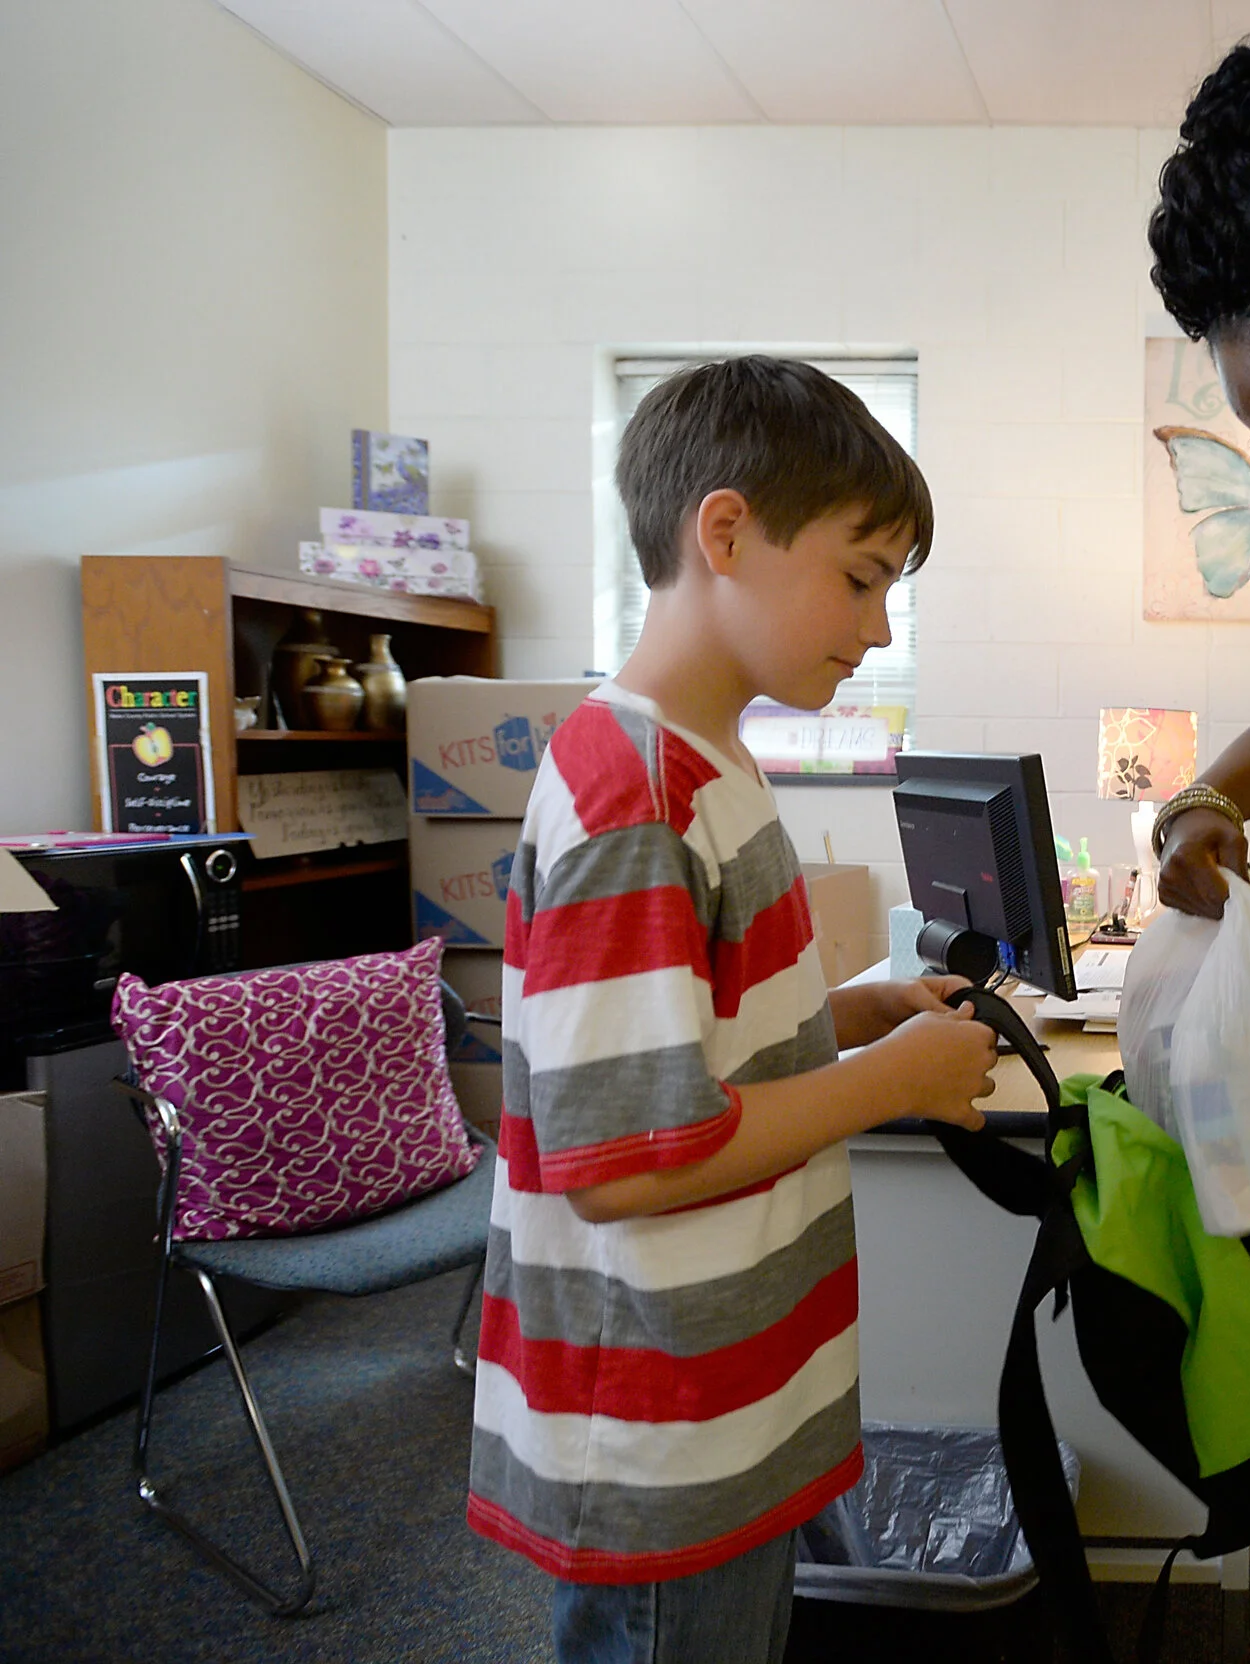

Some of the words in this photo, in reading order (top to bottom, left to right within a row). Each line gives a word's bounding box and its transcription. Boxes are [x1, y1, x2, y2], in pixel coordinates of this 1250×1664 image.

[105, 685, 198, 708] Character
[439, 736, 496, 770] KITS
[440, 872, 495, 902] KITS
